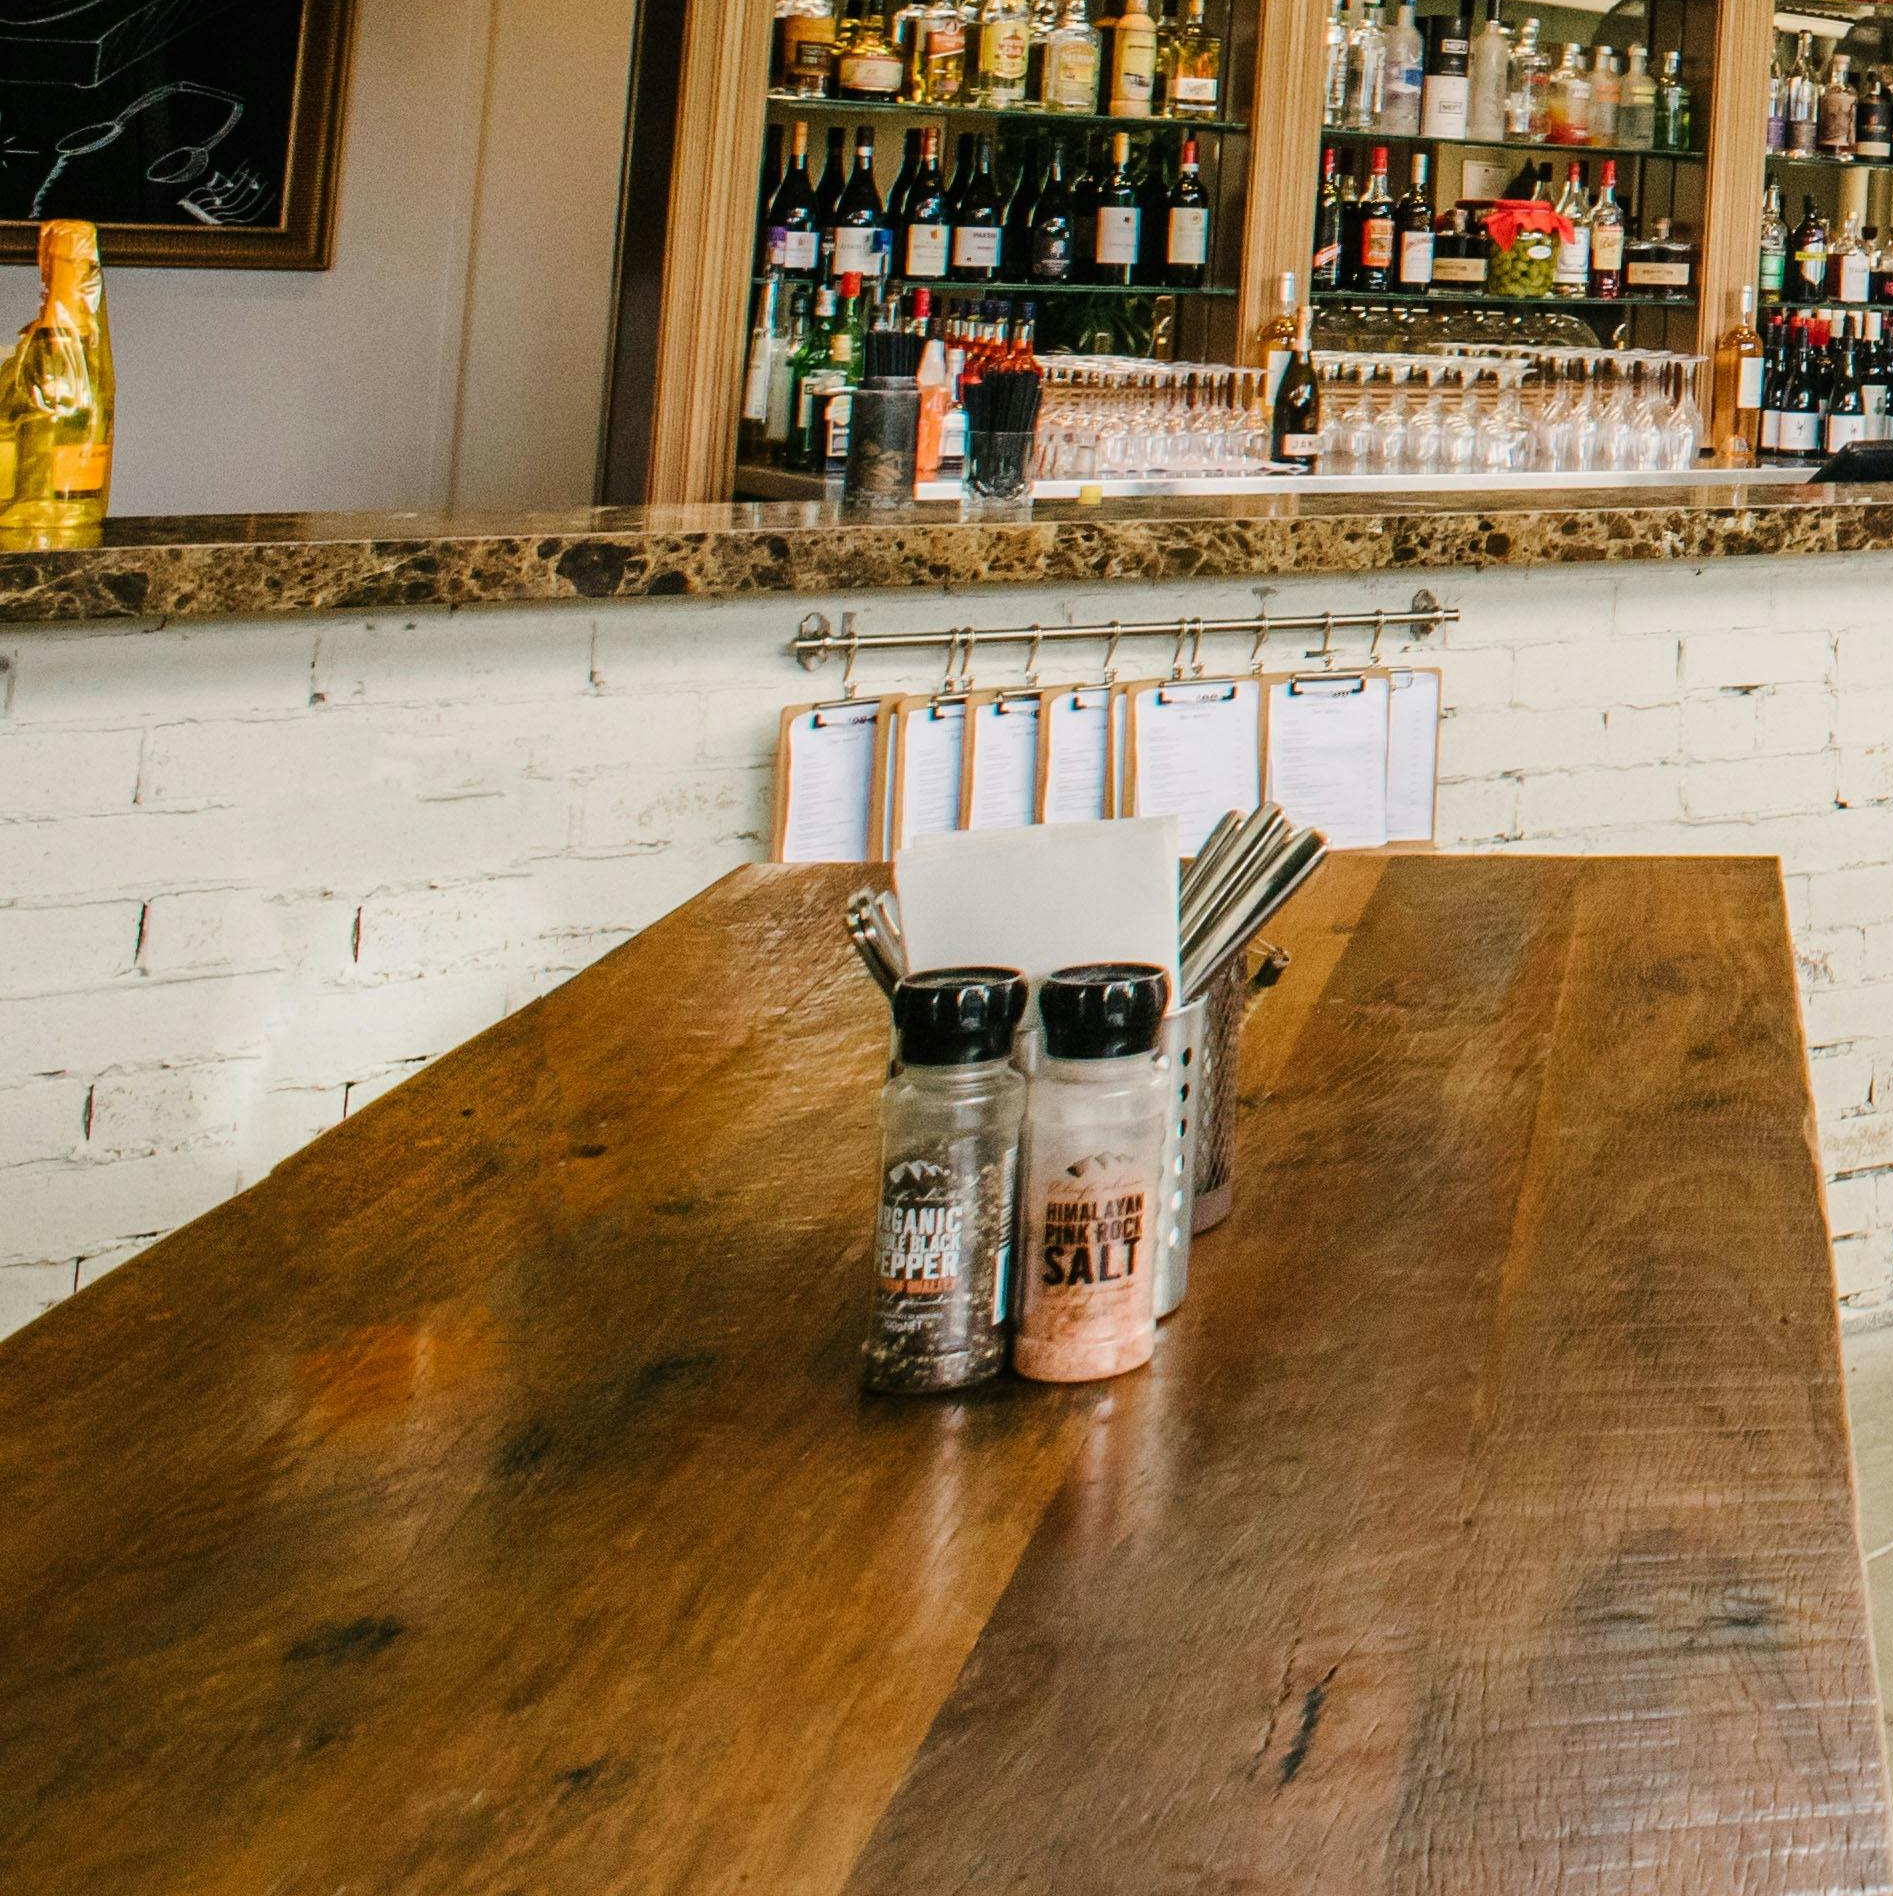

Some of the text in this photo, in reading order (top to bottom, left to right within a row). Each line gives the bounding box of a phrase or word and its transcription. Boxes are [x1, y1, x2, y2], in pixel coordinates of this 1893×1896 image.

[879, 1205, 964, 1236] RGANIC
[1044, 1222, 1090, 1245] PINK
[910, 1231, 962, 1254] BLACK
[880, 1251, 960, 1280] EPPER
[1042, 1236, 1142, 1286] SALT
